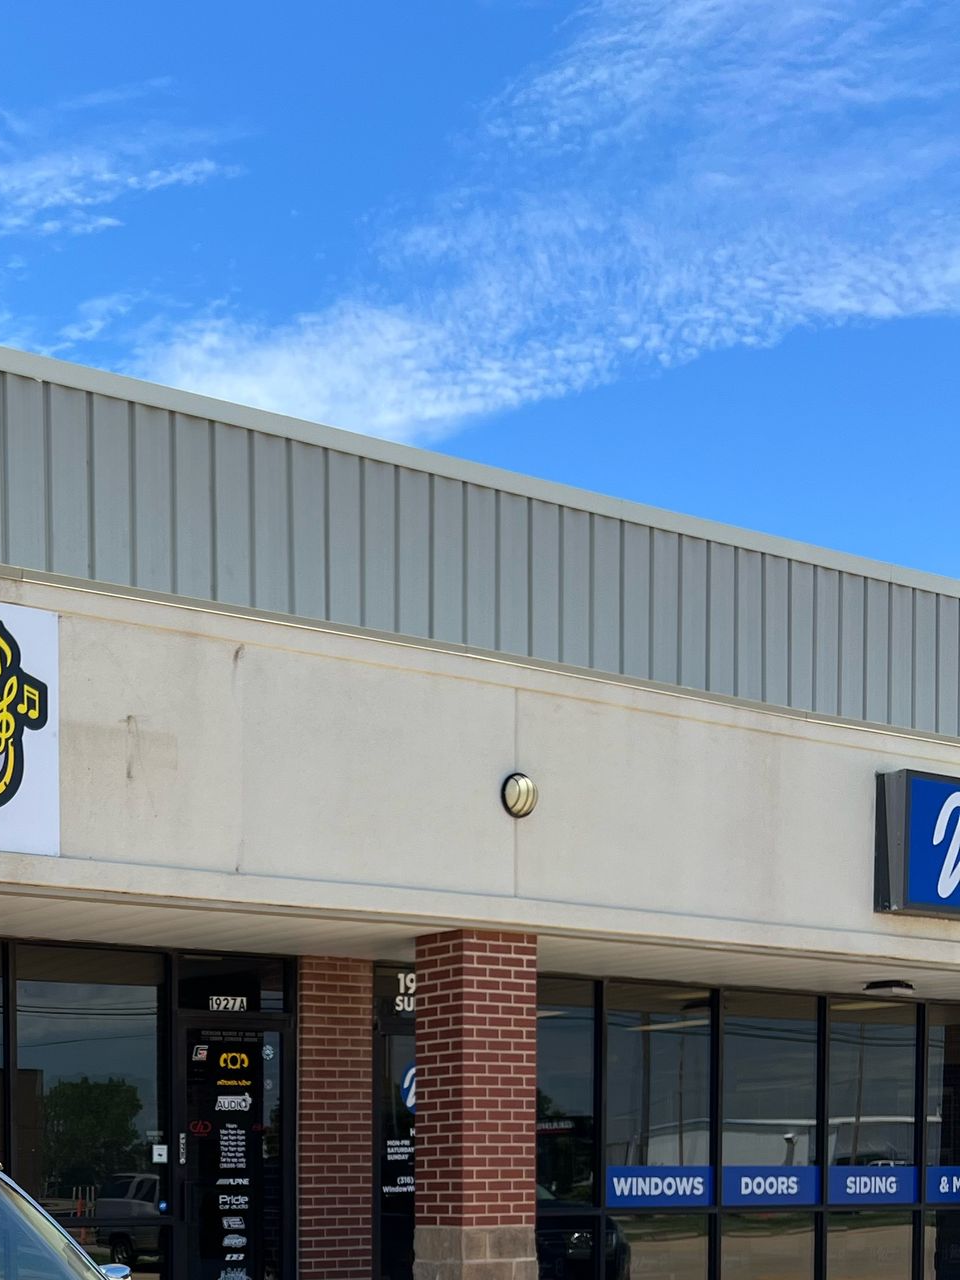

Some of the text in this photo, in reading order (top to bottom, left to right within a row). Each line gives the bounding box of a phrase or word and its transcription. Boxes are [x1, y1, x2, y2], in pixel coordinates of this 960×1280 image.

[216, 1100, 248, 1111] AUDIO
[382, 1185, 415, 1194] WindowW
[613, 1177, 704, 1196] WINDOWS
[740, 1176, 799, 1195] DOORS
[846, 1176, 898, 1195] SIDING
[939, 1175, 949, 1193] &
[219, 1195, 249, 1204] Pride
